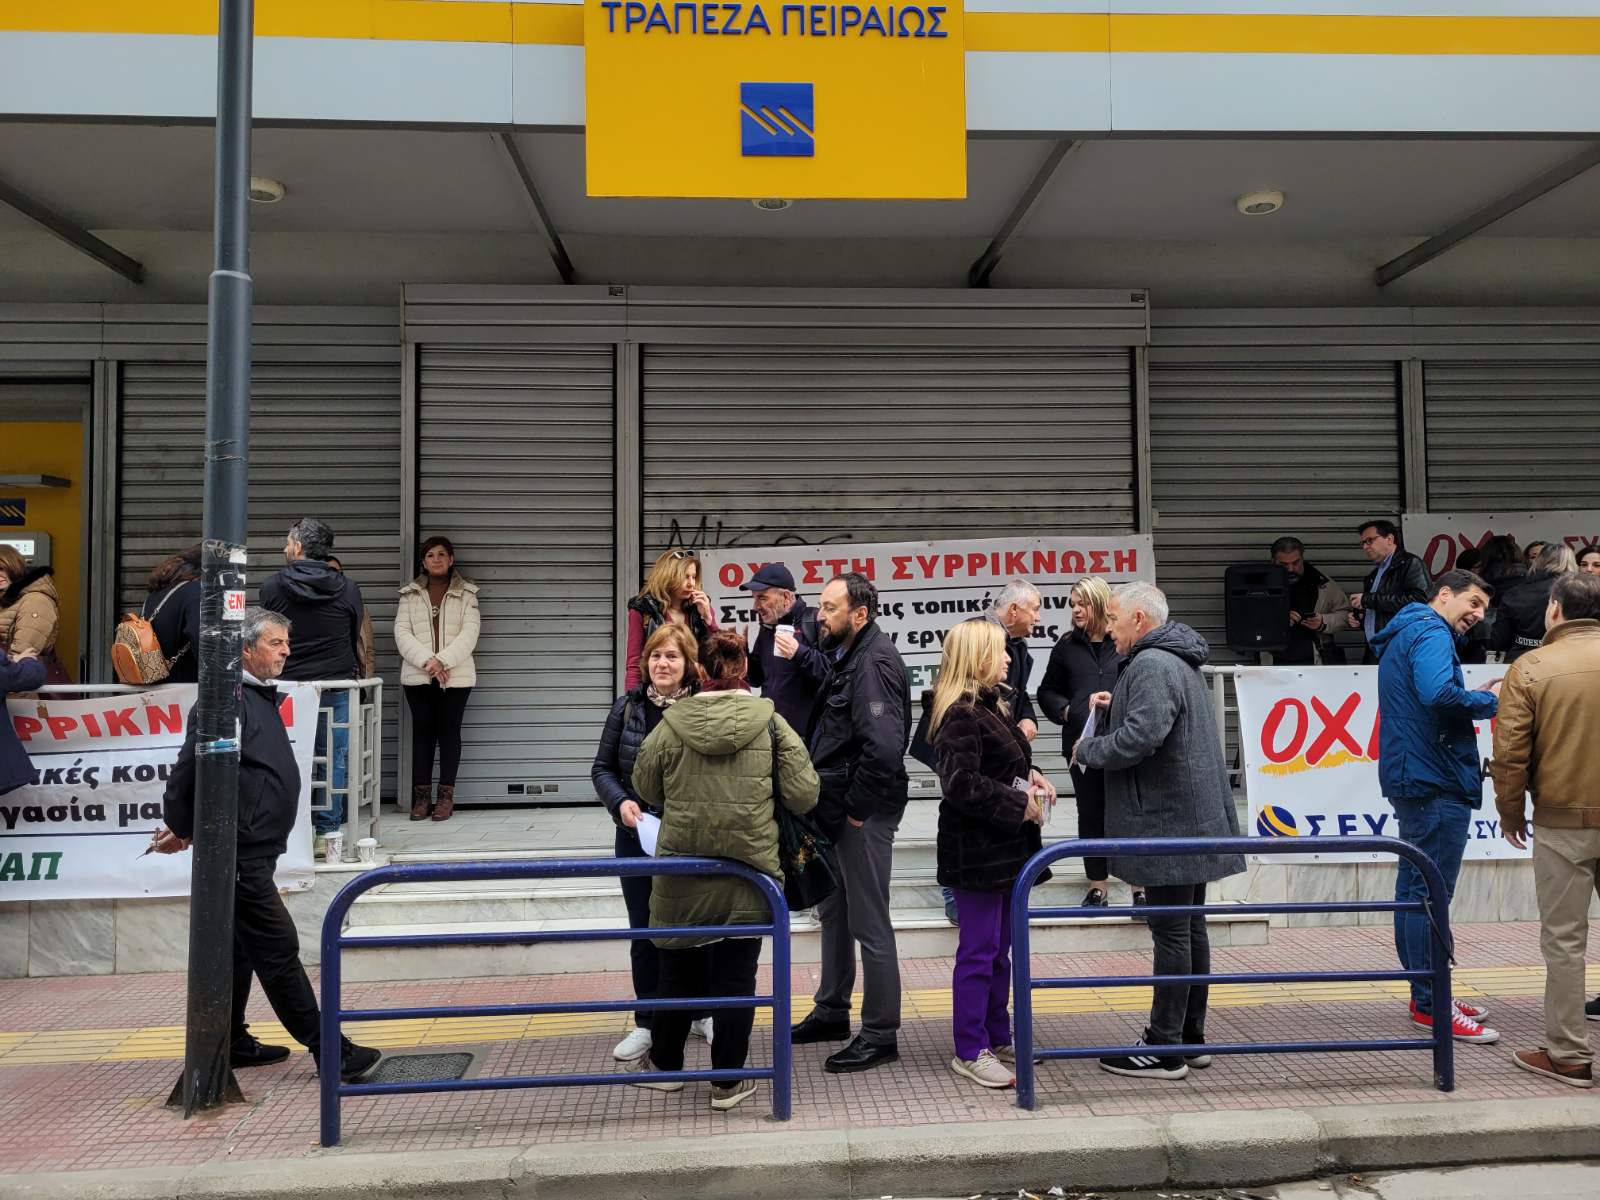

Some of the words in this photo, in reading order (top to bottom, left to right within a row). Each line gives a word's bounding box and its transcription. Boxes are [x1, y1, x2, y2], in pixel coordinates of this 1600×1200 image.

[602, 2, 771, 35] ΤΡΑΠΕΖΑ
[782, 5, 948, 38] ΠΕΙΡΑΙΩΣ
[802, 558, 875, 584] ΣΤΗ
[892, 549, 1137, 580] ΣΥΡΡΙΚΝΩΣΗ
[911, 591, 993, 615] τοπικέ
[907, 629, 949, 649] εργ
[1025, 624, 1060, 643] ας
[13, 703, 183, 742] ΡΡΙΚΝ
[30, 758, 101, 790] ικές
[112, 764, 177, 784] κοι
[118, 802, 165, 828] μα
[1304, 814, 1400, 837] ΣΕΥ
[0, 851, 64, 882] ΑΠ
